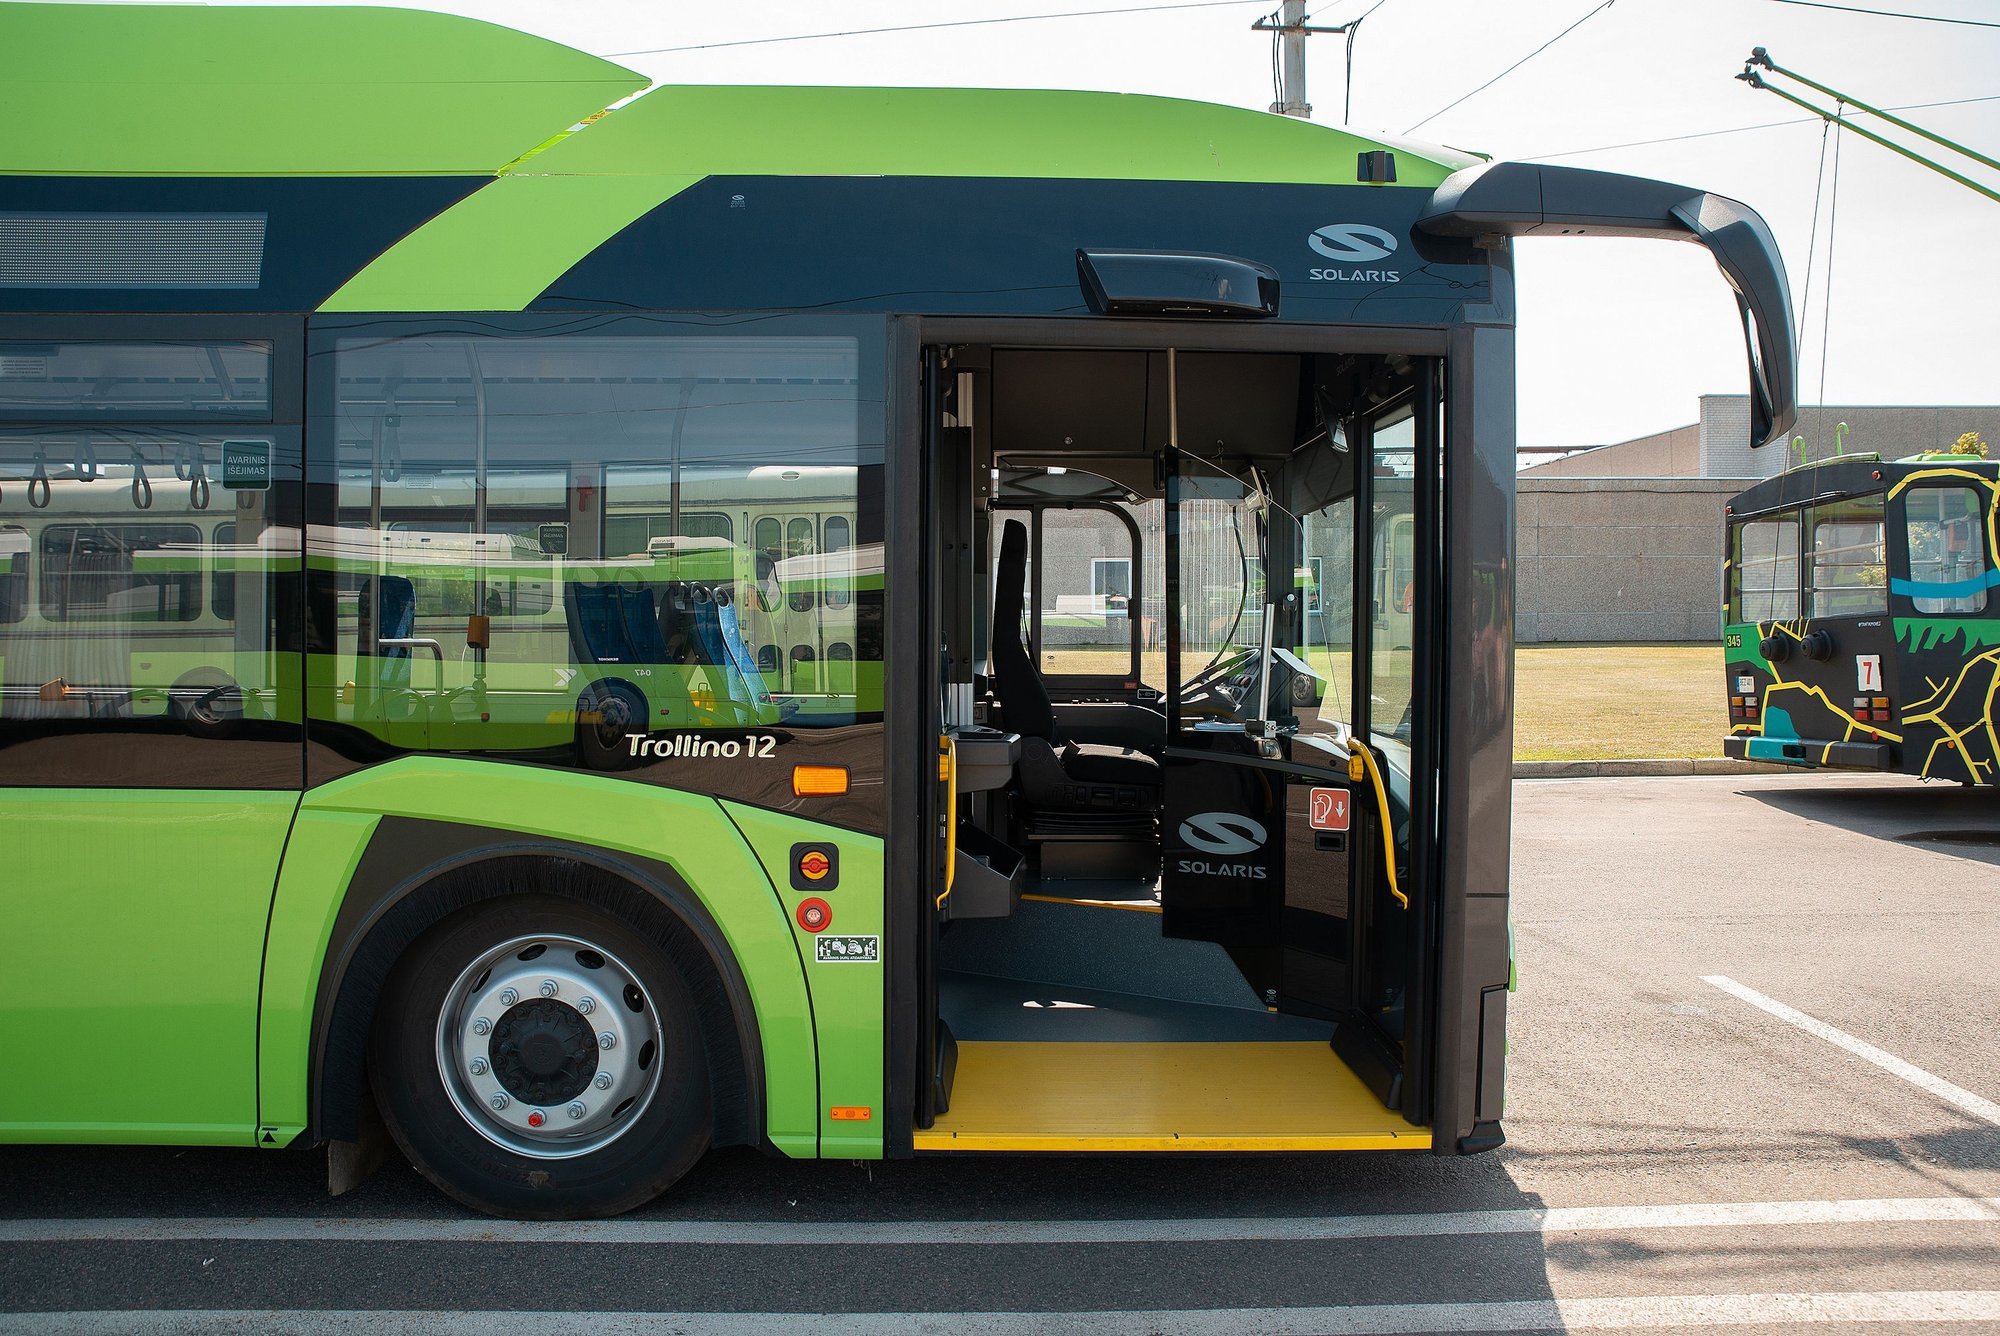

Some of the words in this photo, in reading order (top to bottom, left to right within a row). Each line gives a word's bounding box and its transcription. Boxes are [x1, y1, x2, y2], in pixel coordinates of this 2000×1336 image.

[1309, 268, 1400, 283] SOLARIS
[227, 456, 266, 464] AVARINIS
[227, 465, 266, 475] IŠĖJIMAS
[1727, 635, 1741, 647] 345
[1863, 661, 1872, 685] 7
[625, 733, 741, 758] Trollino
[745, 734, 777, 758] 12
[1178, 860, 1267, 879] SOLARIS
